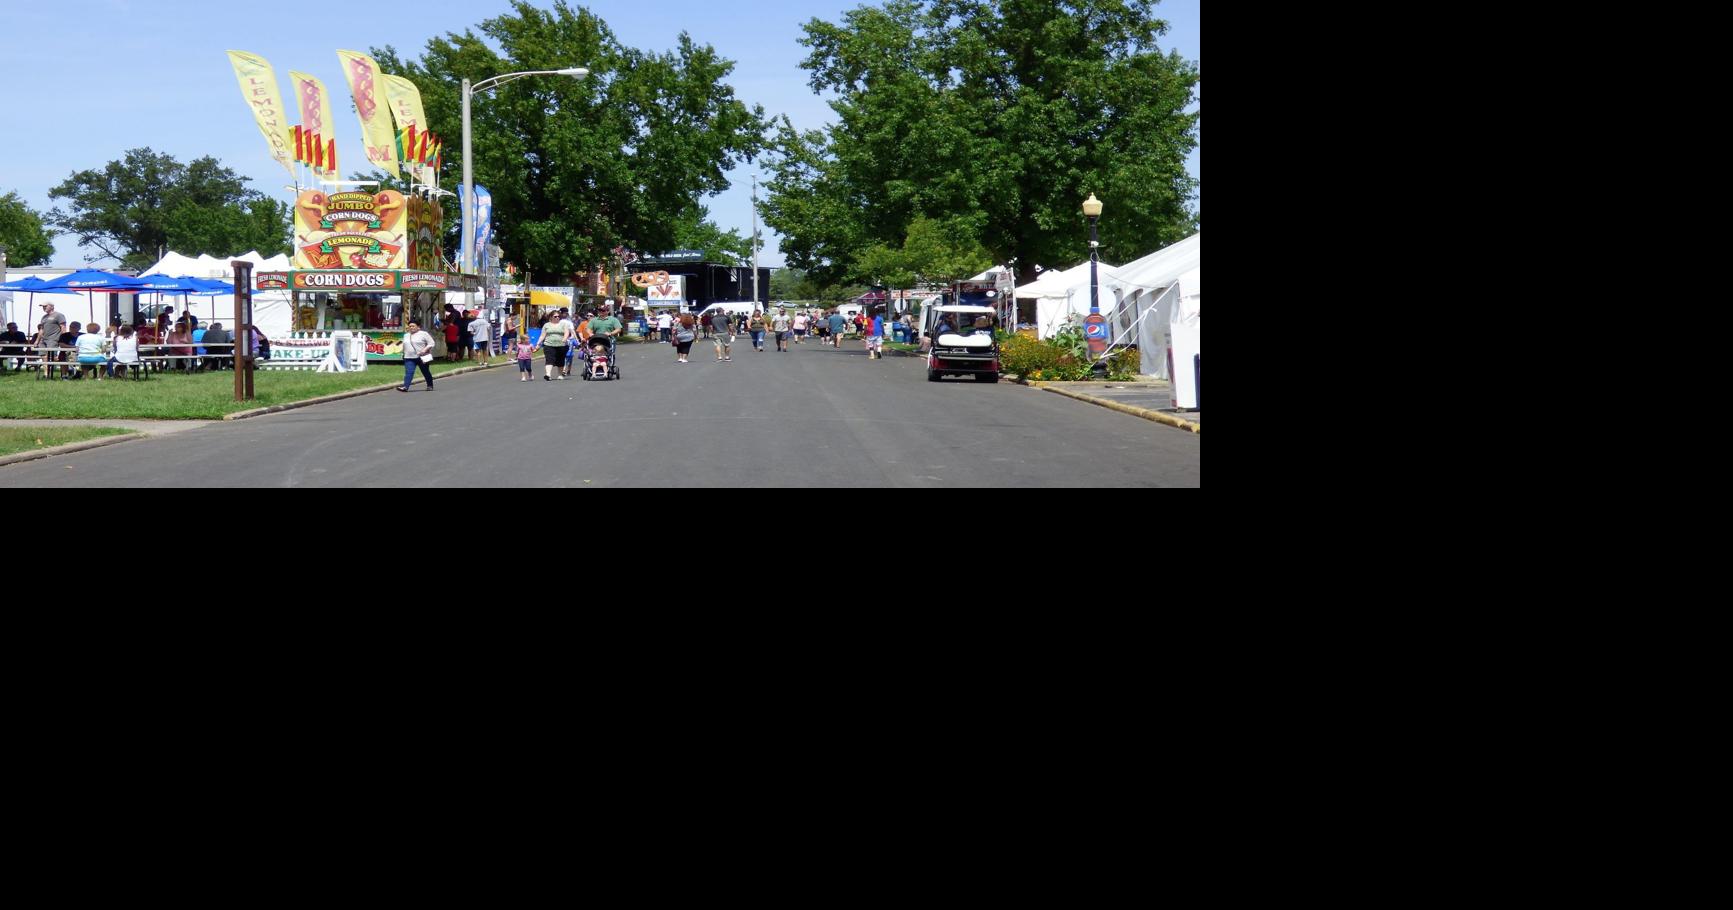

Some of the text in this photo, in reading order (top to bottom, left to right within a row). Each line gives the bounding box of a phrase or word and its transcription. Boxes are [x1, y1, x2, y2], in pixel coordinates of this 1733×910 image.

[331, 193, 372, 201] HAND DIPPED
[327, 202, 375, 211] JUMBO
[325, 212, 377, 221] CORN DOGS
[327, 236, 374, 246] LEMONADE
[305, 273, 385, 286] CORN DOGS
[402, 274, 418, 283] FRESH
[418, 274, 445, 284] LEMONADE
